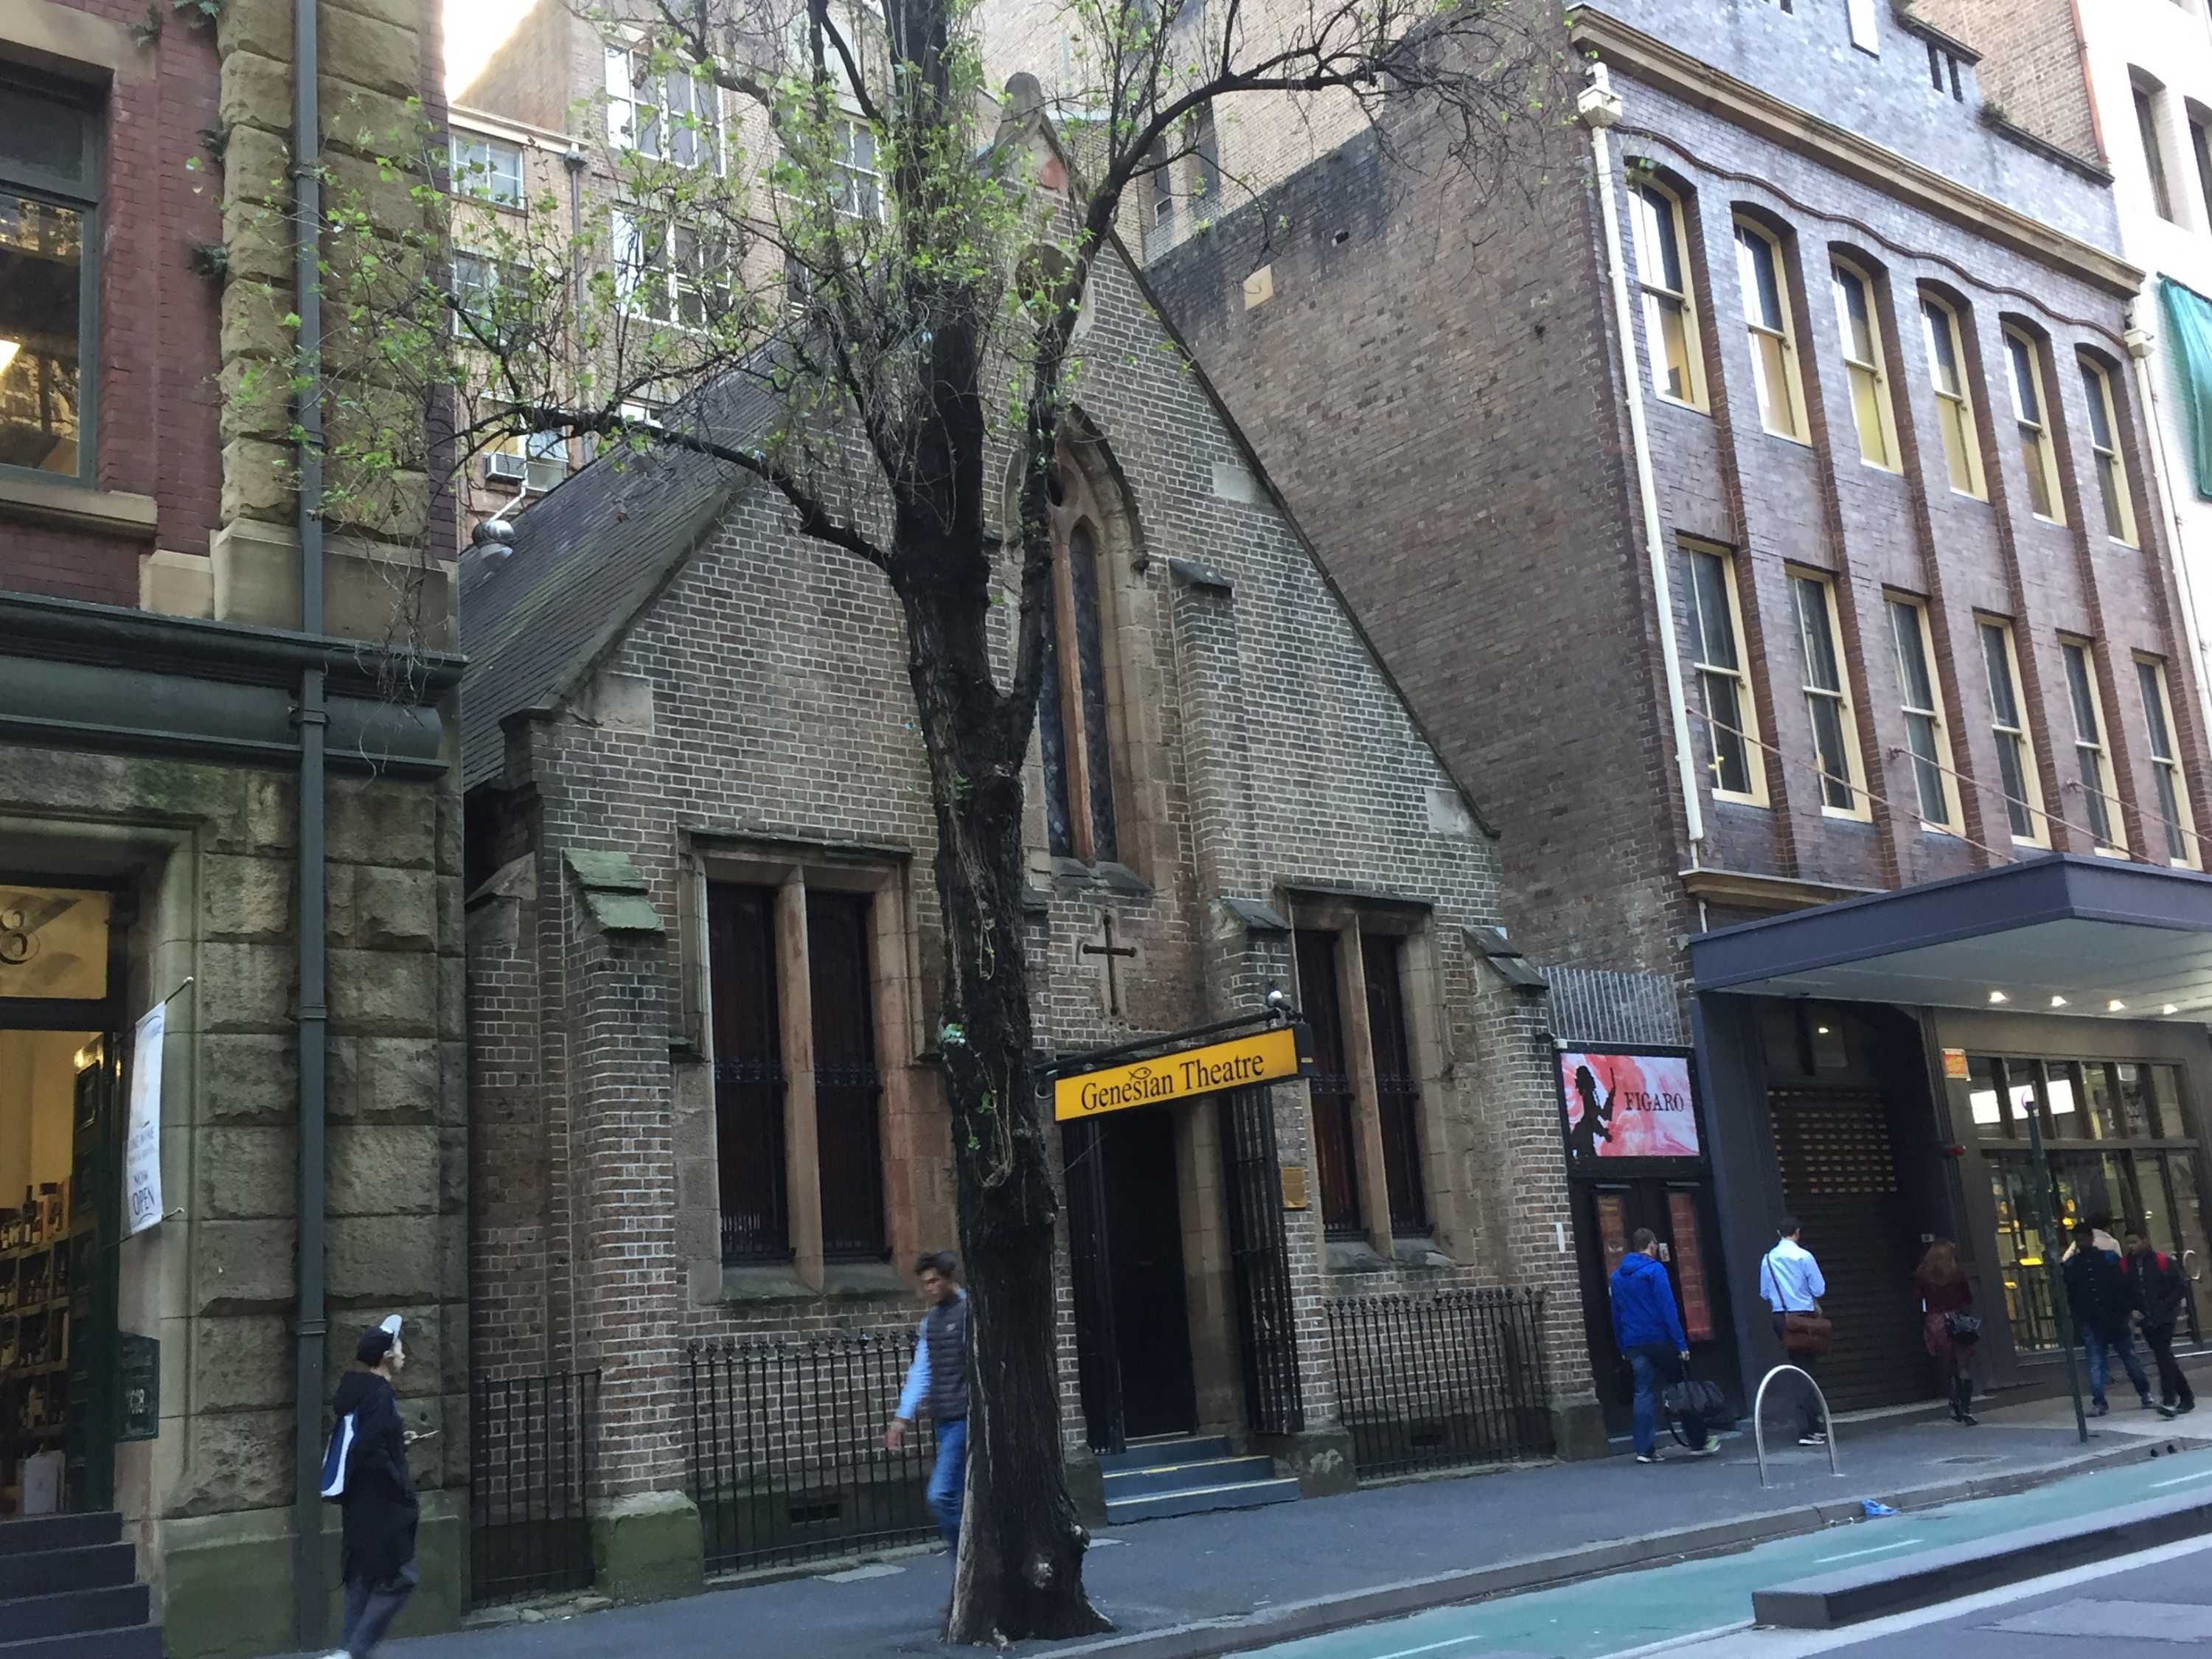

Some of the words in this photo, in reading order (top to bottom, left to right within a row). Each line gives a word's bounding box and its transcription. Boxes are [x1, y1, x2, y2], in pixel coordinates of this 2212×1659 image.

[1081, 1074, 1174, 1110] Genesian
[1180, 1054, 1264, 1091] Theatre
[1624, 1091, 1684, 1113] FIGARO
[132, 1185, 156, 1216] OPEN
